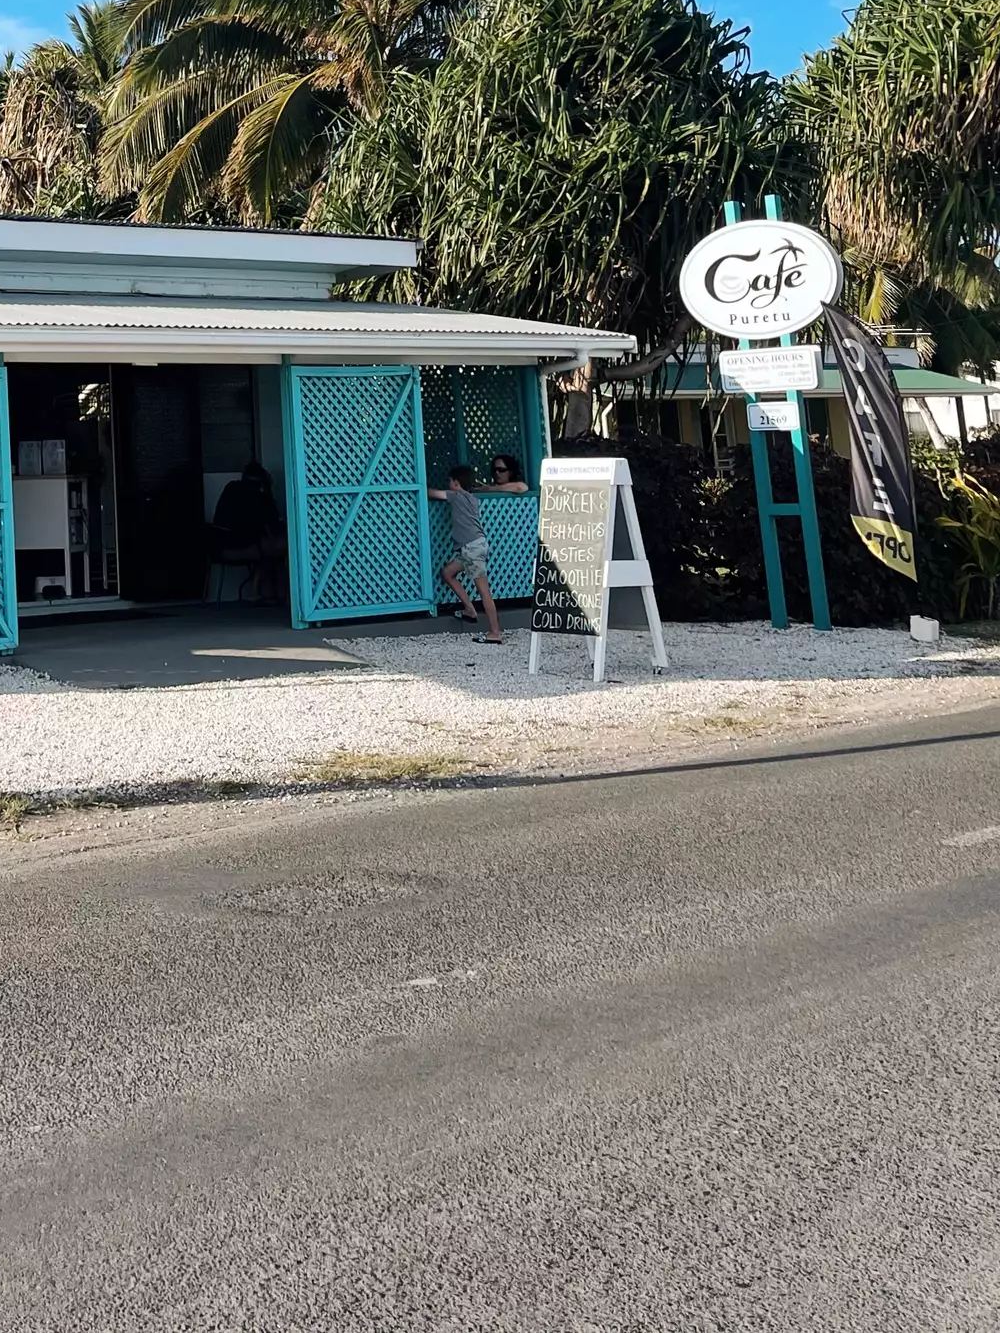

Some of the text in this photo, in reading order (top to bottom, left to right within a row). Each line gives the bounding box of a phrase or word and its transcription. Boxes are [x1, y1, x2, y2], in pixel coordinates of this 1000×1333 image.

[729, 312, 791, 325] Puretu
[727, 354, 769, 366] OPENING
[771, 352, 804, 363] HOURS
[760, 415, 787, 426] 21569
[539, 544, 595, 562] TOASTIES
[532, 609, 601, 632] COLD DRINKS
